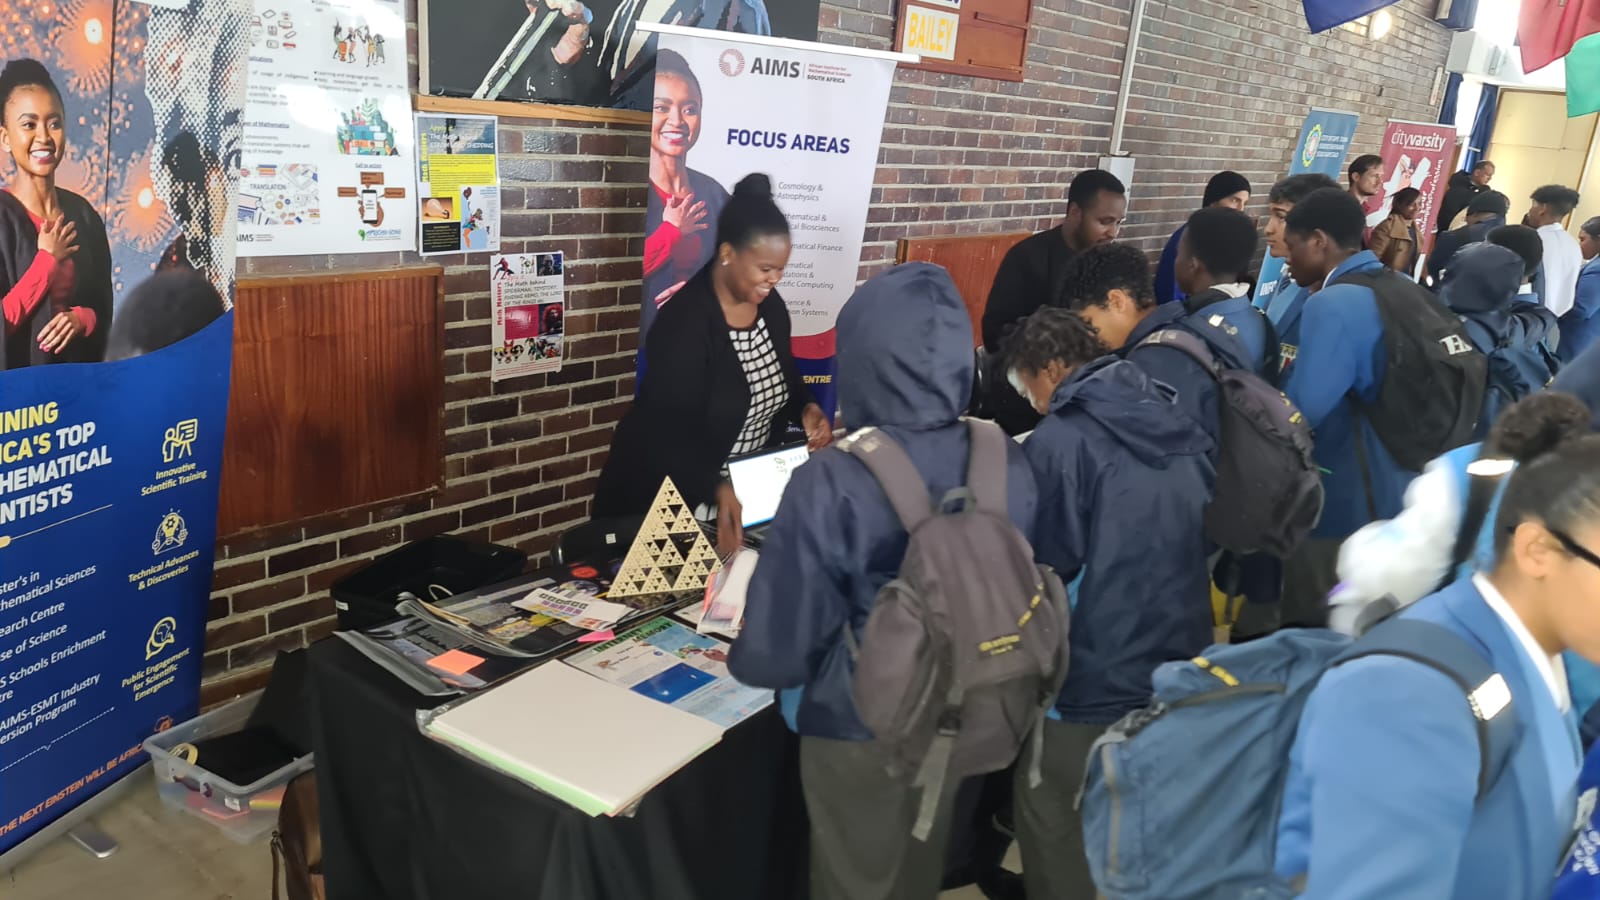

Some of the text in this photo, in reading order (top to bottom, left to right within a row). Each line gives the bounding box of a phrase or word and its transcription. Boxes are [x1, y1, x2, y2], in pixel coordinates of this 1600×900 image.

[908, 12, 955, 53] BAILEY
[750, 57, 800, 78] AIMS
[727, 128, 850, 154] FOCUS AREAS
[1391, 129, 1447, 151] cityvarsity
[249, 183, 287, 191] TRANSLATION
[777, 193, 819, 202] Astrophysics
[778, 182, 817, 192] Cosmology
[800, 222, 840, 232] Biosciences
[817, 243, 843, 252] Finance
[796, 280, 834, 290] Computing
[801, 308, 828, 317] Systems
[56, 421, 96, 449] TOP
[141, 470, 207, 496] Scientific Training
[155, 462, 196, 480] Innovative
[30, 571, 40, 586] in
[54, 565, 96, 590] Sciences
[128, 549, 199, 583] Technical Advances
[138, 564, 188, 591] & Discoveries
[30, 601, 65, 623] Centre
[15, 639, 27, 655] of
[28, 623, 67, 648] Science
[9, 658, 49, 685] Schools
[51, 630, 107, 663] Enrichment
[121, 648, 190, 688] Public Engagement
[61, 673, 101, 700] Industry
[133, 663, 177, 693] for Scientific
[135, 675, 175, 702] Emergence
[35, 697, 77, 726] Program
[19, 805, 44, 825] NEXT
[45, 779, 84, 809] EINSTEIN
[85, 766, 105, 784] WILL
[106, 759, 118, 771] BE
